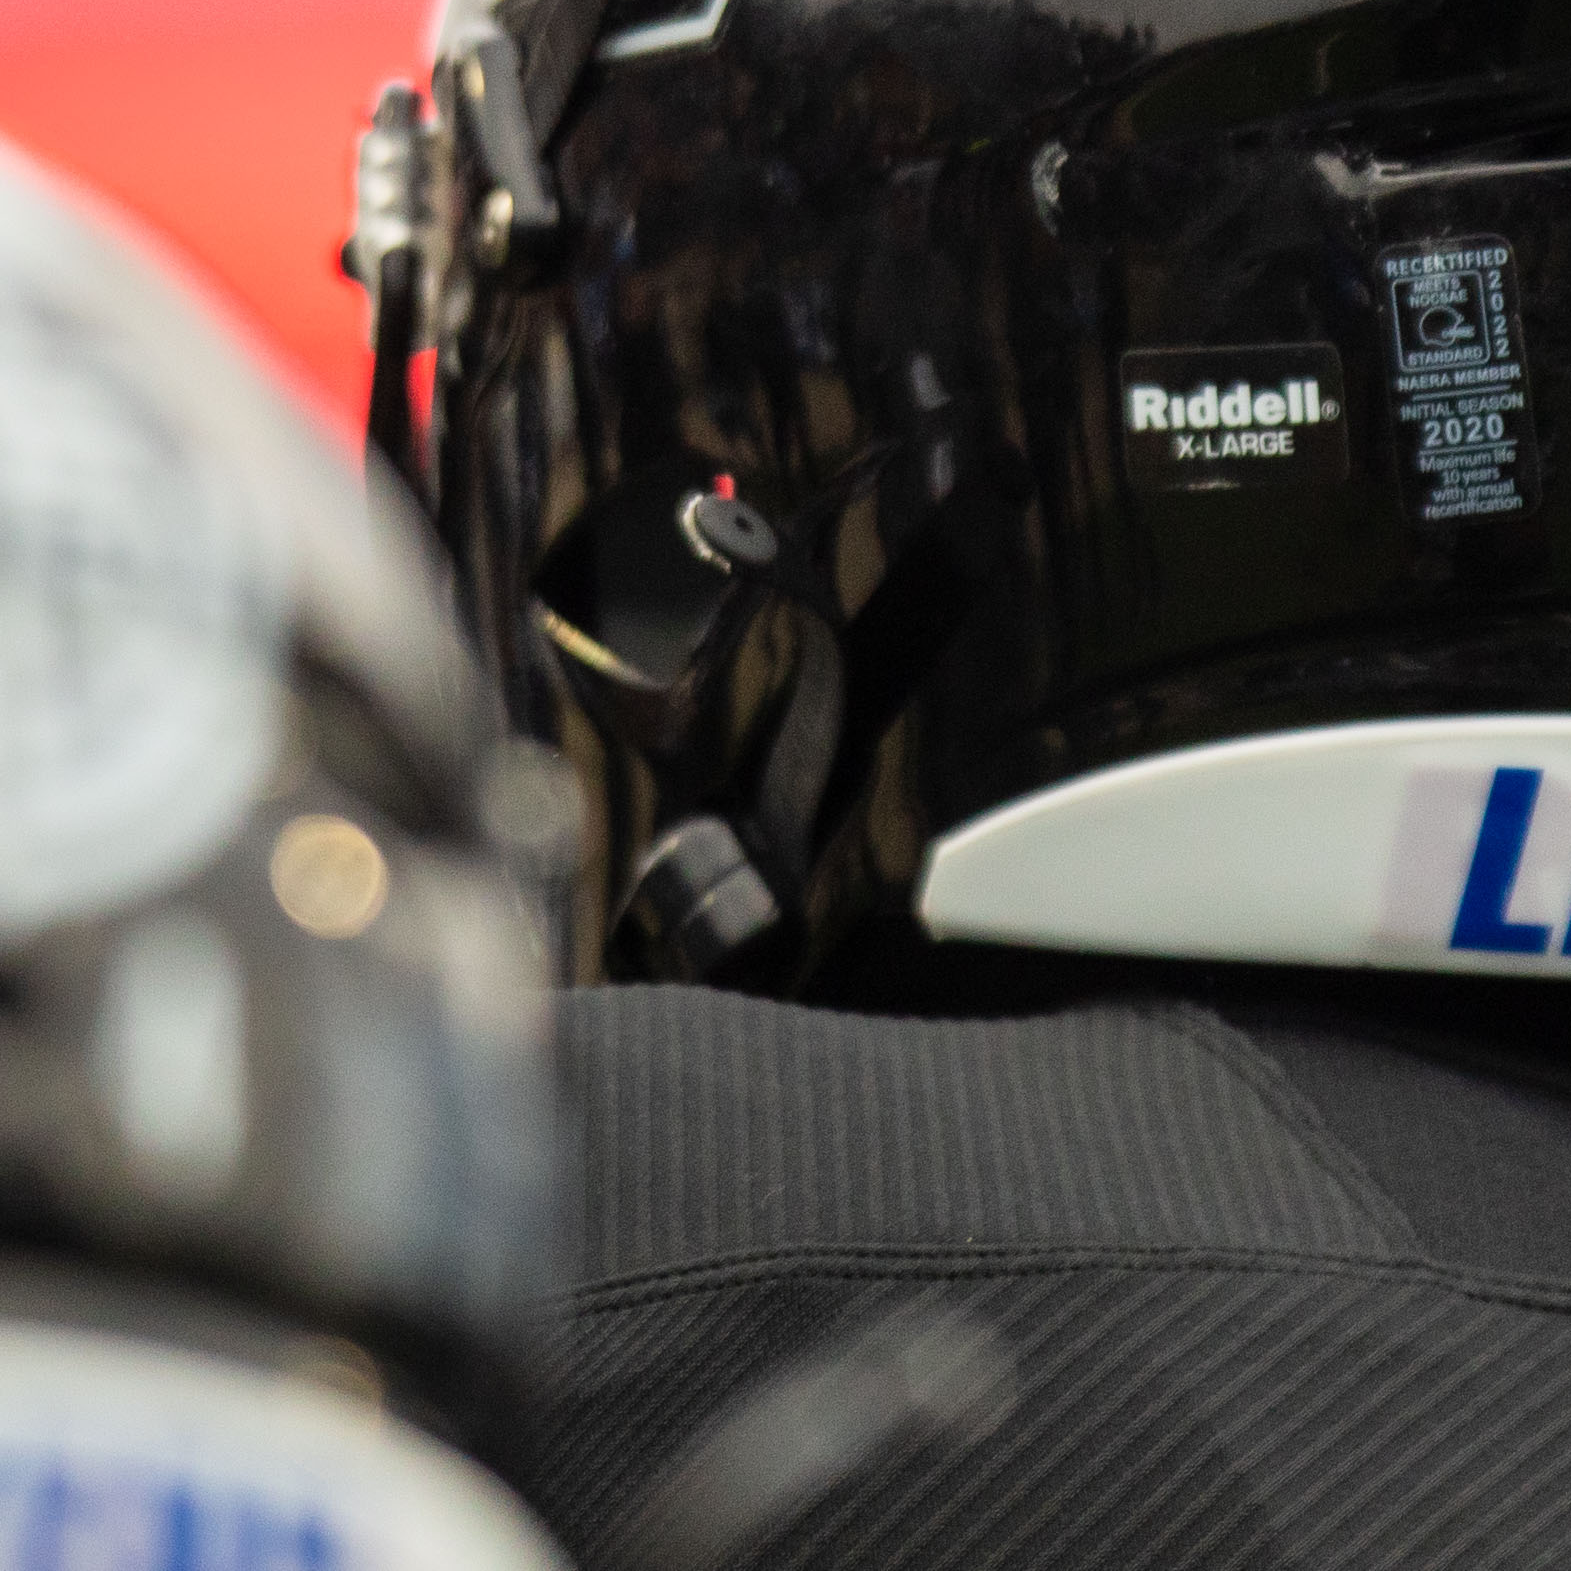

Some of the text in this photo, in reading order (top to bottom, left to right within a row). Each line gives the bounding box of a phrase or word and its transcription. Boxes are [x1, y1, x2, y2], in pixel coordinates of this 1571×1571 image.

[1386, 248, 1508, 277] RECERTIFIED
[1408, 346, 1484, 366] STANDARD
[1398, 363, 1522, 391] NAERA MEMBER
[1400, 392, 1524, 421] INITIAL SEASON
[1424, 413, 1505, 447] 2020
[1177, 429, 1295, 461] X-LARGE
[1419, 451, 1492, 473] Maximum
[1462, 467, 1500, 486] years
